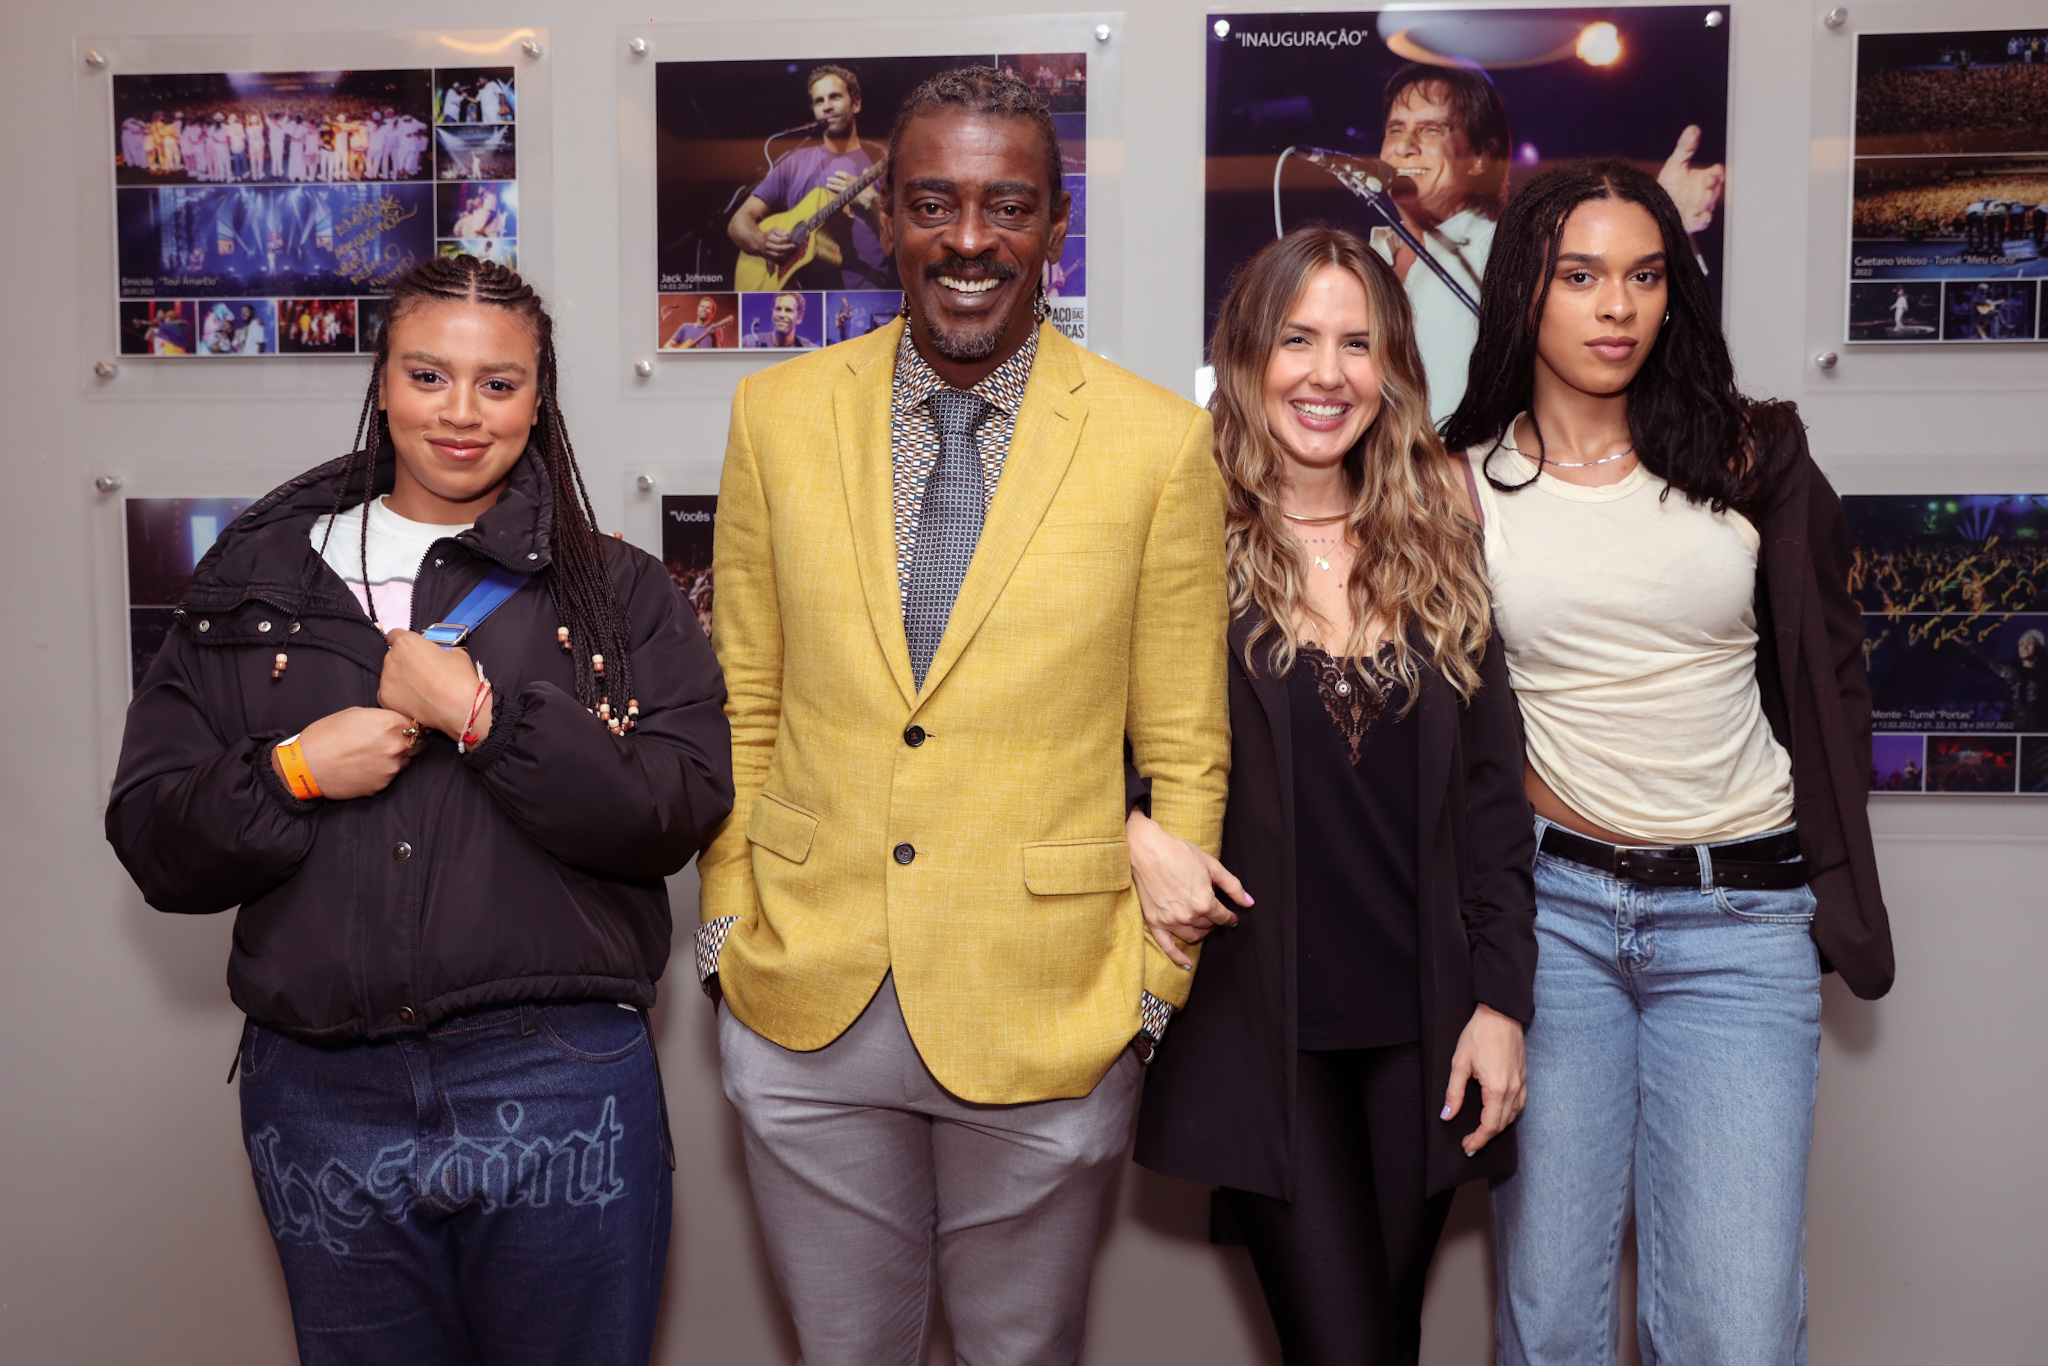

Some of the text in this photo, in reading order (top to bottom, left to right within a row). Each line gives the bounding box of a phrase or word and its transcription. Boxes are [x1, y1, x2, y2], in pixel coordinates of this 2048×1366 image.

[1235, 28, 1368, 50] "INAUGURAÇÃO"
[1854, 256, 1893, 266] Caetano
[1894, 255, 1927, 265] Veloso
[1934, 255, 1961, 265] Turné
[661, 274, 723, 283] Jack Johnson
[1871, 710, 1902, 720] Monte
[1908, 709, 1935, 720] Turné
